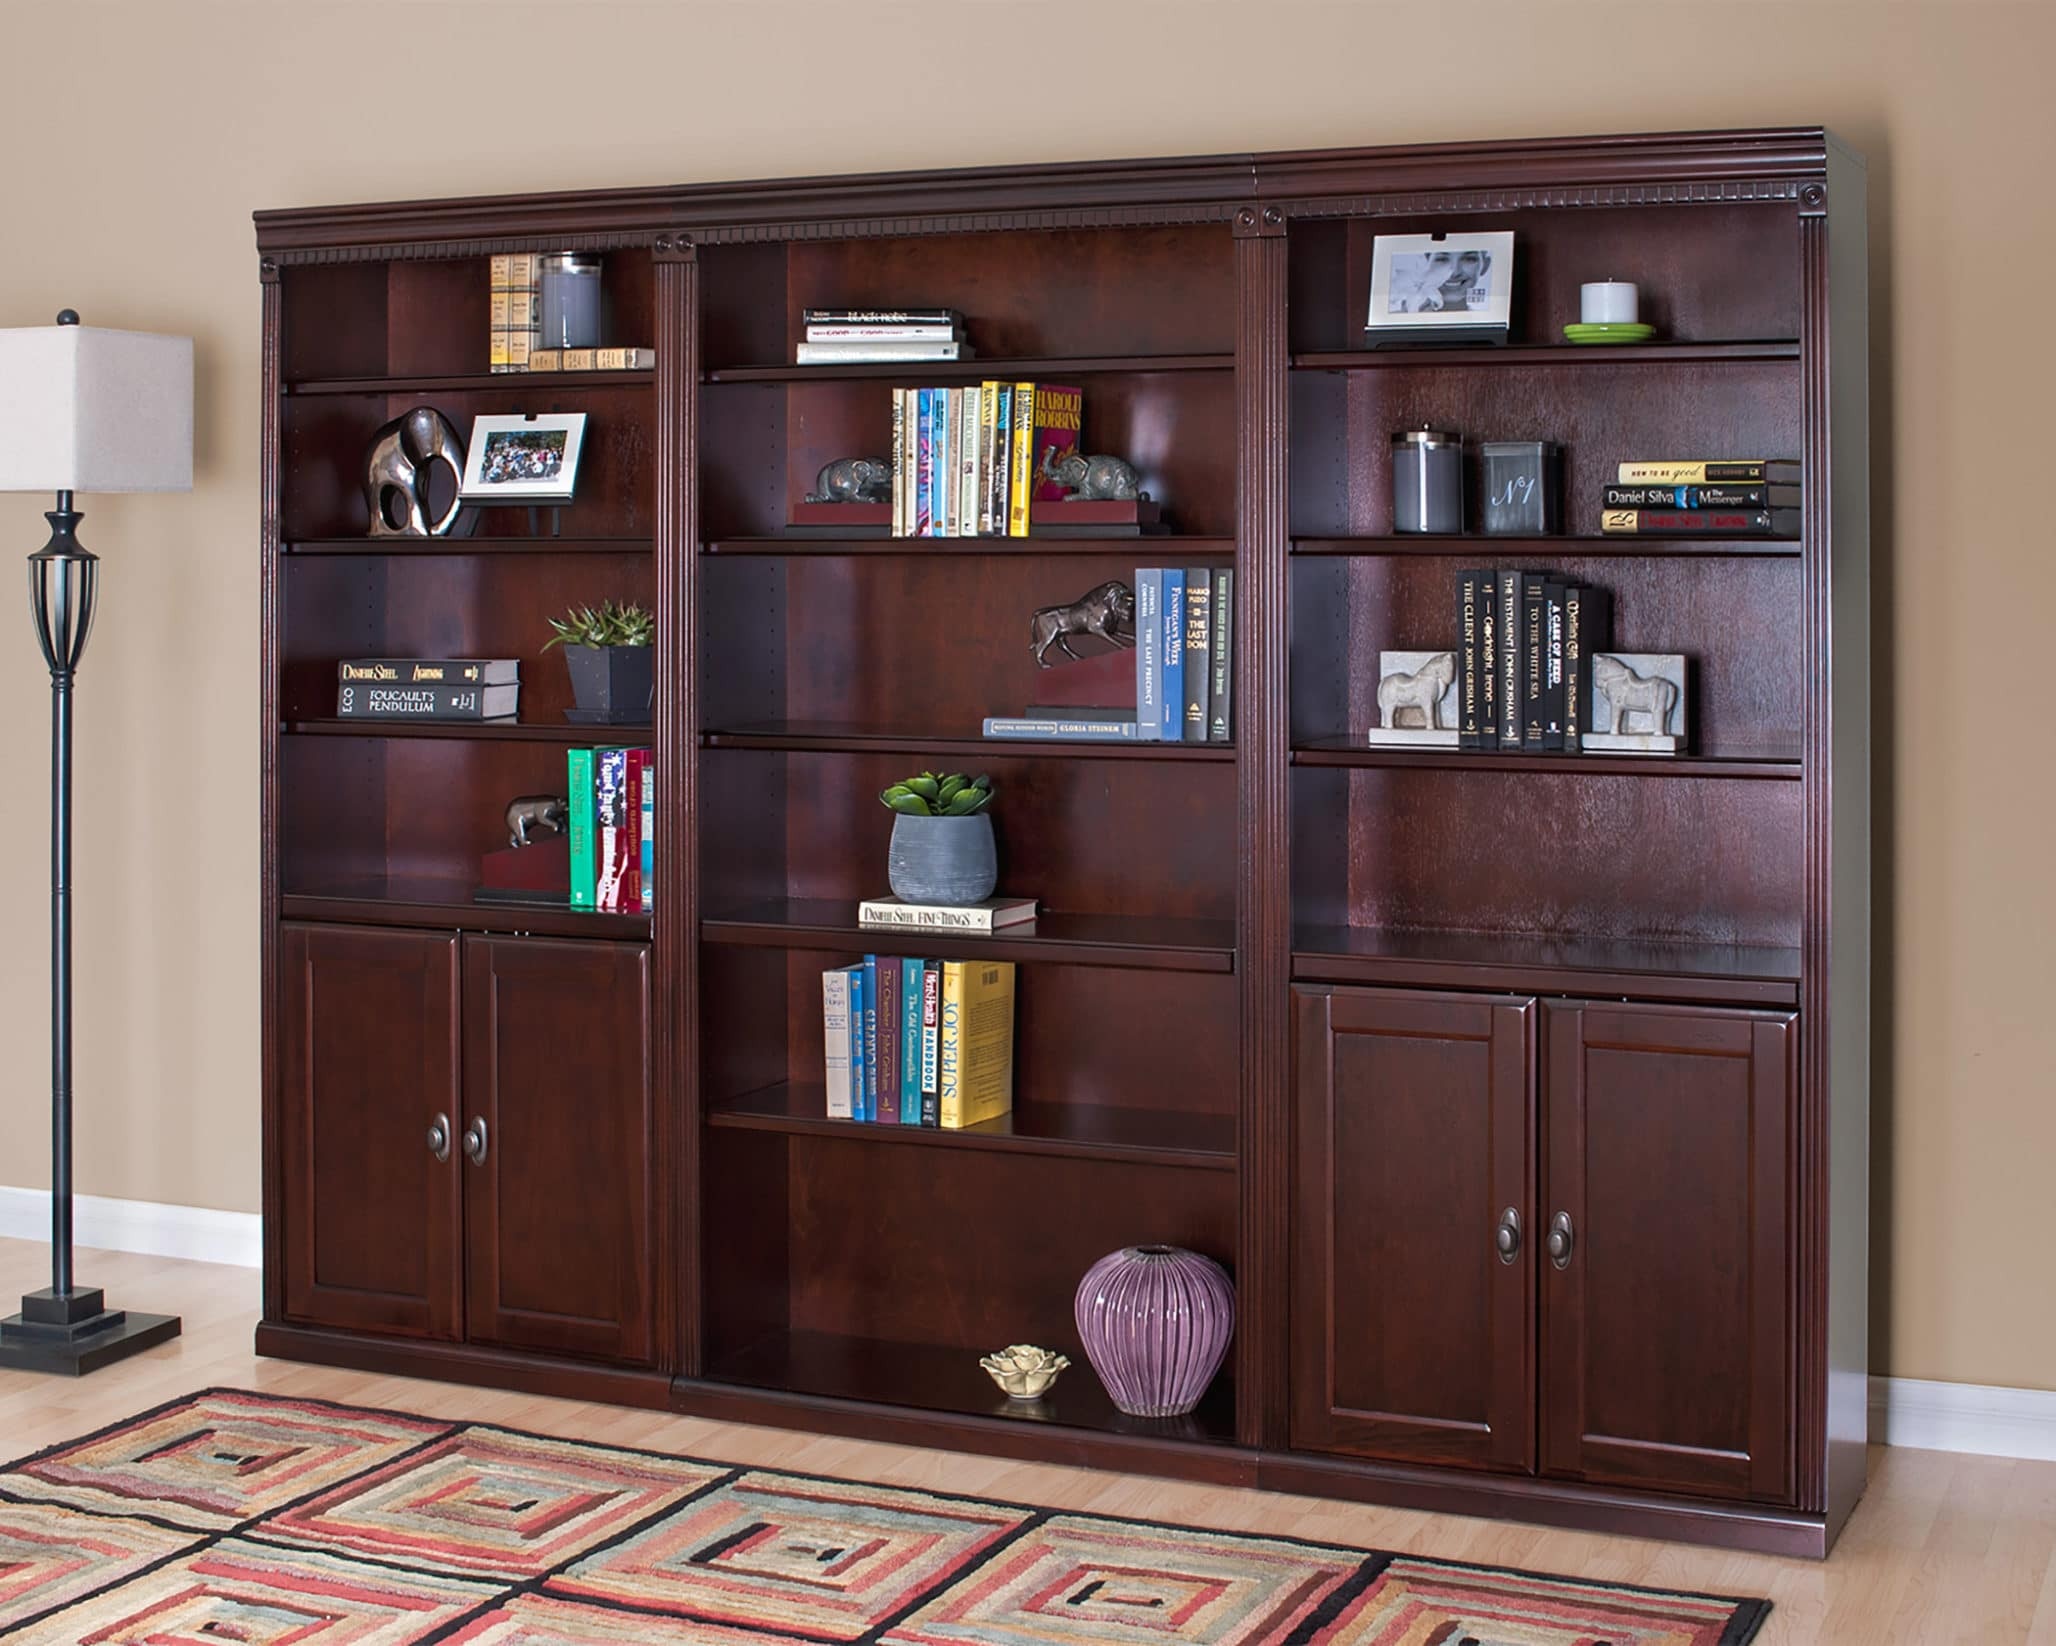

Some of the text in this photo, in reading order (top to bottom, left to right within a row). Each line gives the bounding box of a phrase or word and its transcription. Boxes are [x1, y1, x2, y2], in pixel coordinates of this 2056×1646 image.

[1036, 390, 1081, 412] HAROLD
[1034, 409, 1081, 430] ROBBINS
[1672, 464, 1702, 482] good
[1608, 490, 1674, 504] Daniel Silva
[1700, 492, 1744, 505] Messenger
[1187, 630, 1208, 640] LAST
[1188, 620, 1206, 630] THE
[1552, 614, 1560, 640] CASE
[1171, 639, 1181, 666] WEEK
[1187, 640, 1206, 650] DON
[1464, 581, 1474, 714] THE CLIENT JOHN GRISHAM
[1504, 578, 1514, 720] THE TESTAMENT JOHN GRISHAM
[1530, 607, 1540, 700] TO THE WHITE SEA
[1552, 642, 1561, 656] OF
[374, 664, 398, 680] STEEL
[1552, 658, 1561, 684] NEED
[370, 690, 434, 701] FOUCAULT'S
[1144, 667, 1152, 706] PRECINCT
[1484, 674, 1494, 702] Irene
[342, 688, 354, 712] ECO
[369, 701, 434, 712] PENDULUM
[1059, 724, 1086, 732] GLORIA
[629, 810, 637, 856] southern
[918, 912, 936, 924] FINE
[908, 994, 918, 1011] The
[908, 1012, 917, 1027] Old
[944, 999, 958, 1036] JOY
[882, 970, 892, 1091] The Chamber John Grisham
[924, 1029, 934, 1089] HANDBOOK
[943, 1039, 958, 1098] SUPER
